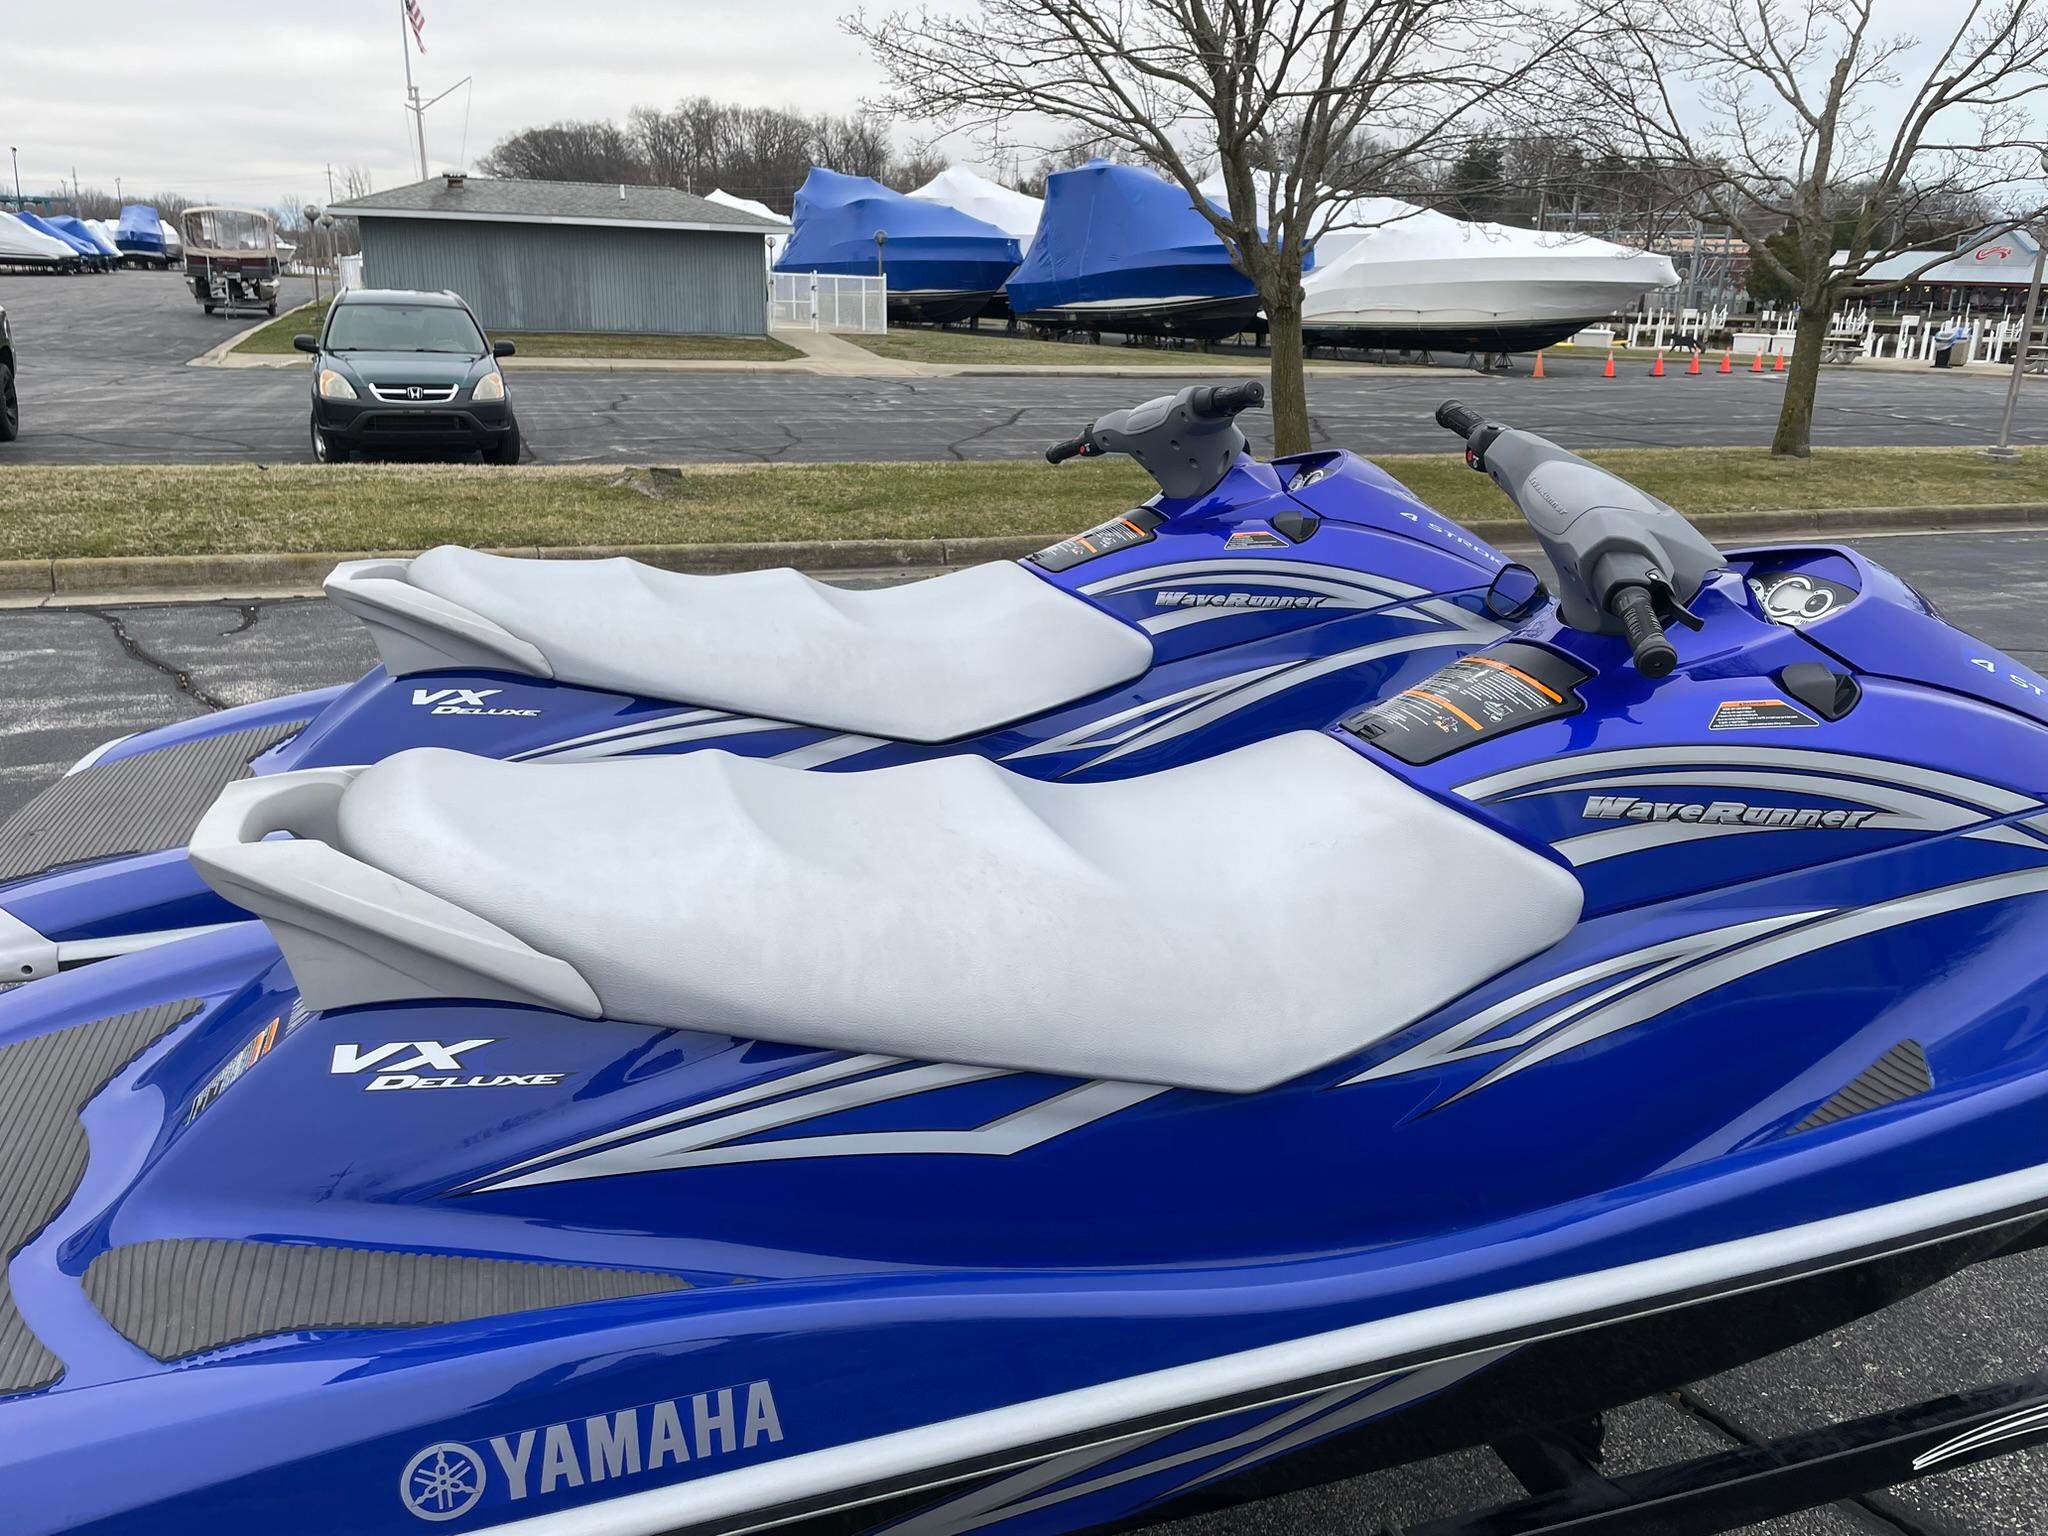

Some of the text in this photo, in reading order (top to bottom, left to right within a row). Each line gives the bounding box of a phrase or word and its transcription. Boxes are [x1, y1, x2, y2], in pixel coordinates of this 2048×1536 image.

[1400, 511, 1418, 521] 4
[1155, 591, 1328, 609] WaveRunner
[1970, 658, 1996, 673] 4
[412, 689, 503, 706] VX
[1582, 795, 1878, 830] WaveRunner
[331, 1038, 497, 1074] VX
[490, 1379, 784, 1501] YAMAHA
